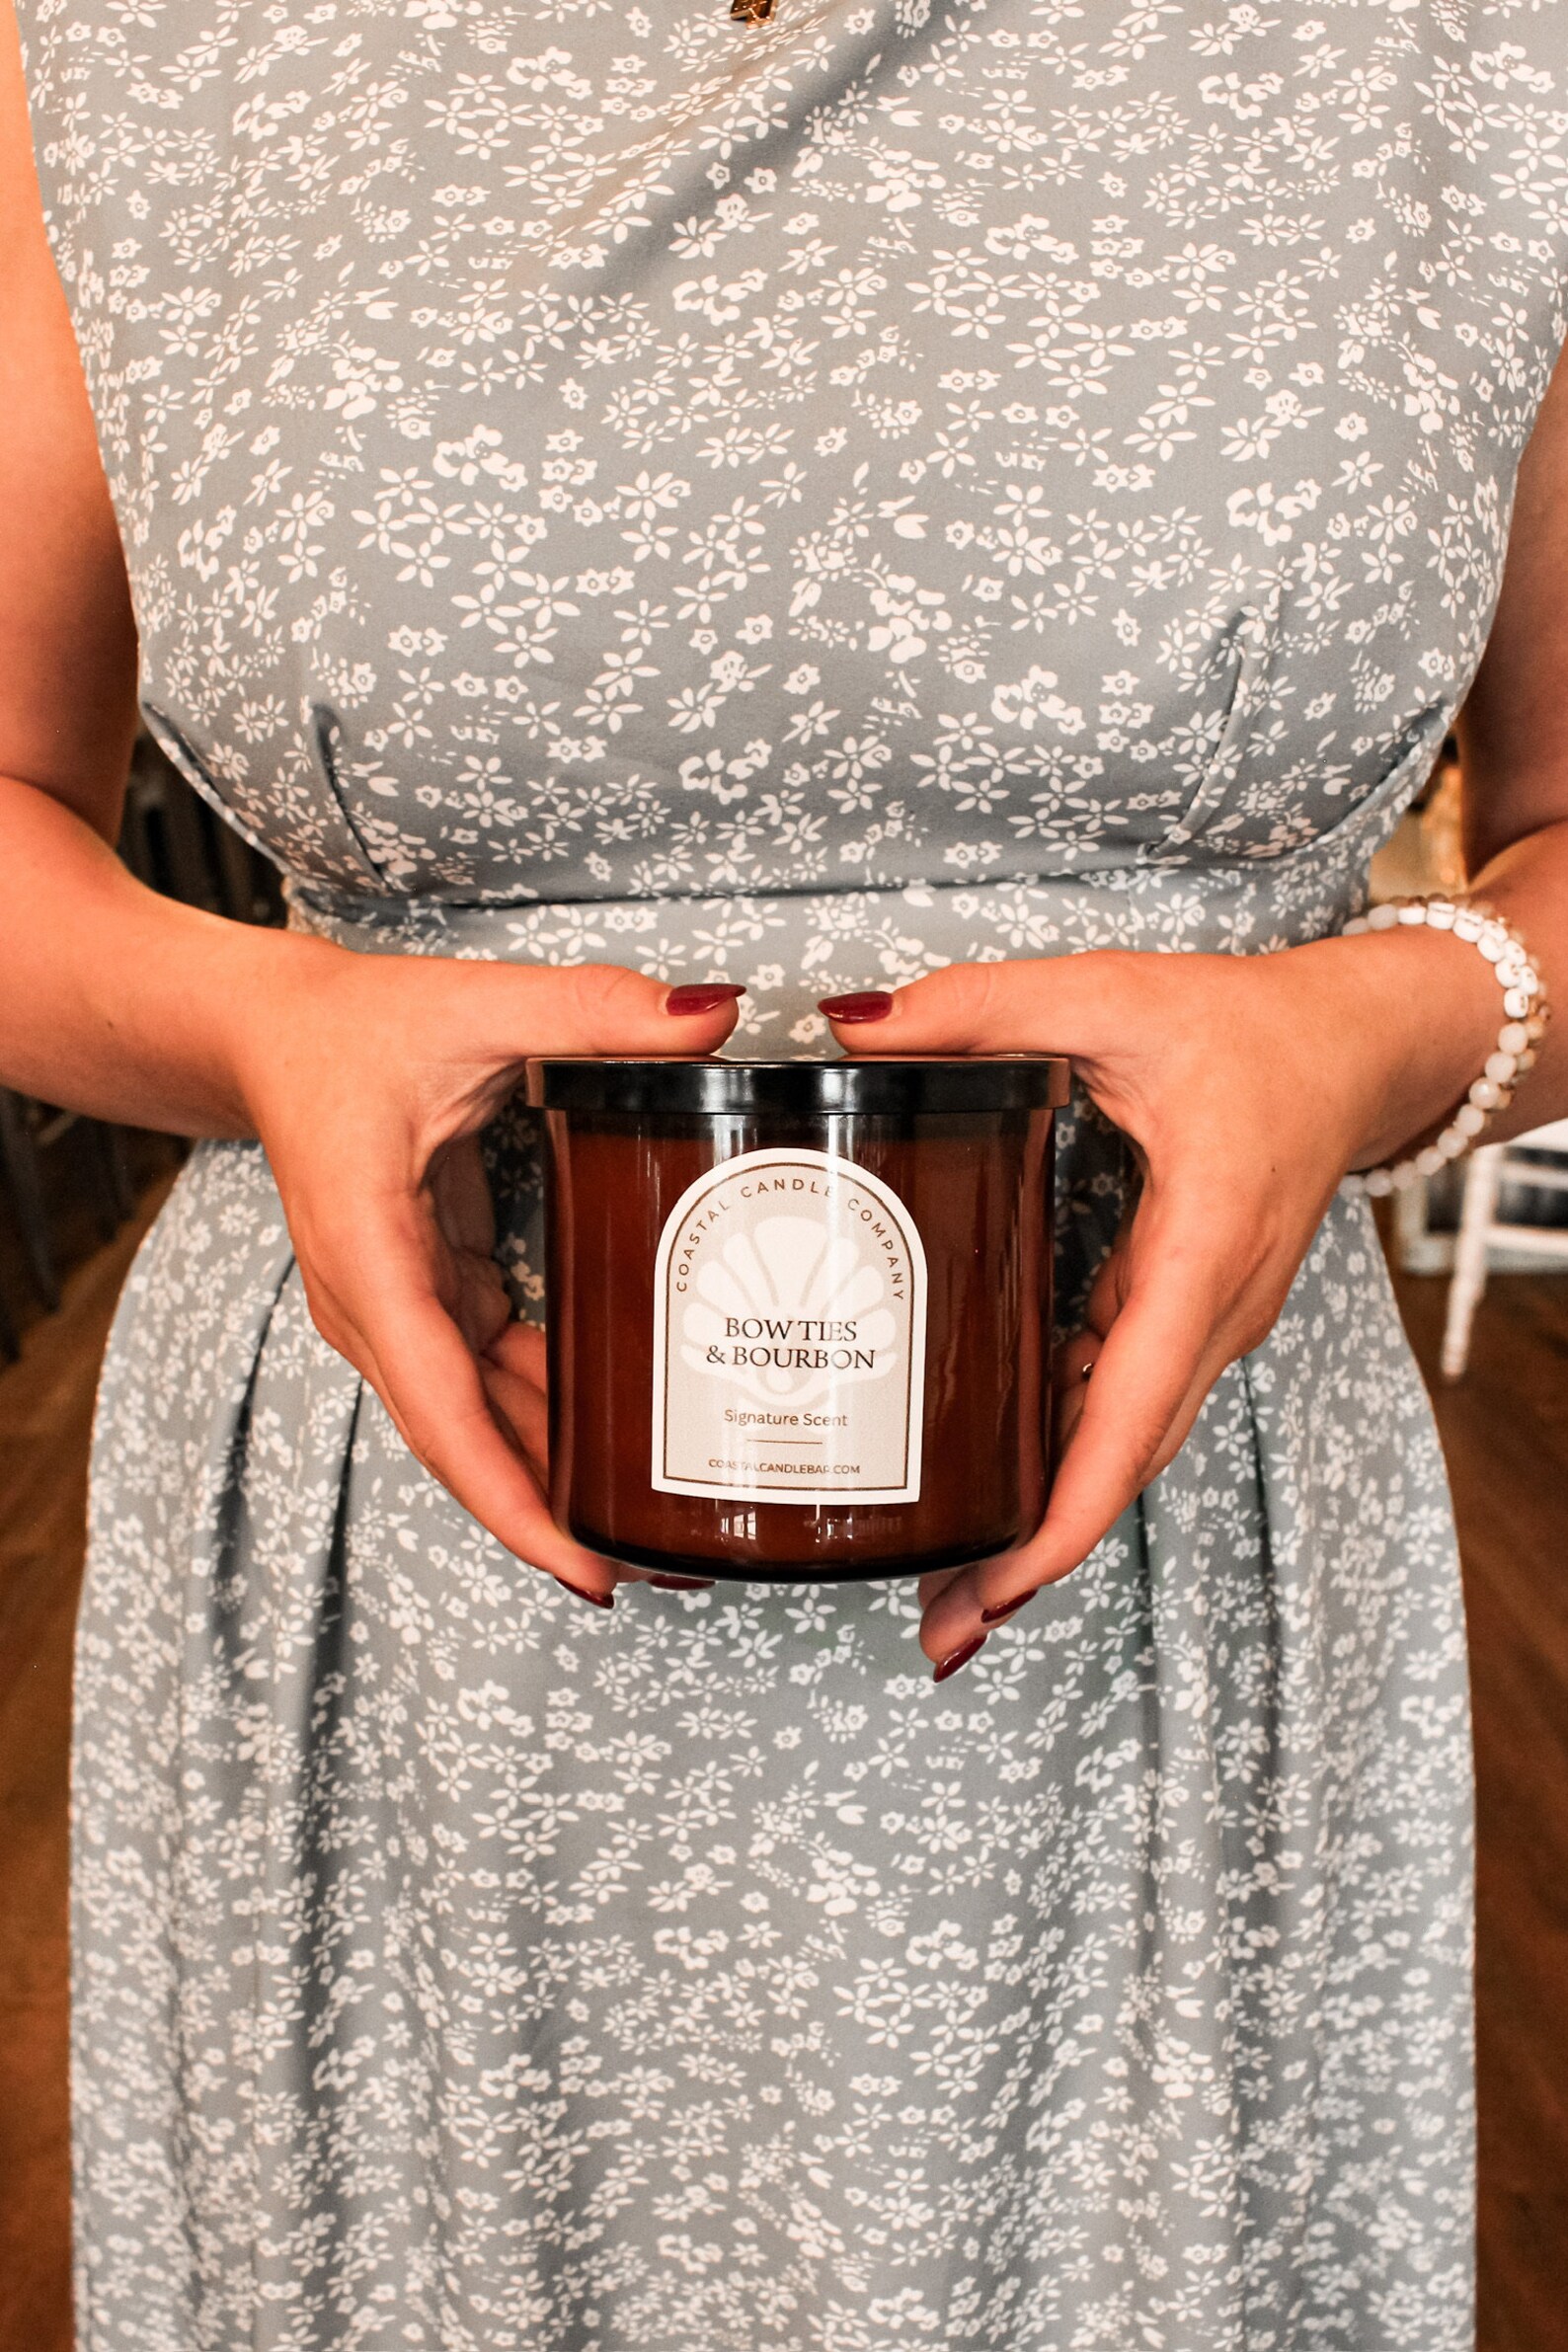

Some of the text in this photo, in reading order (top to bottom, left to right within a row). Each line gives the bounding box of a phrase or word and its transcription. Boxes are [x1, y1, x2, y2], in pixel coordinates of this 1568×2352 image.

[675, 1178, 904, 1300] COASTAL CANDLE COMPANY
[706, 1344, 876, 1370] & BOURBON
[724, 1409, 849, 1427] Signature Scent
